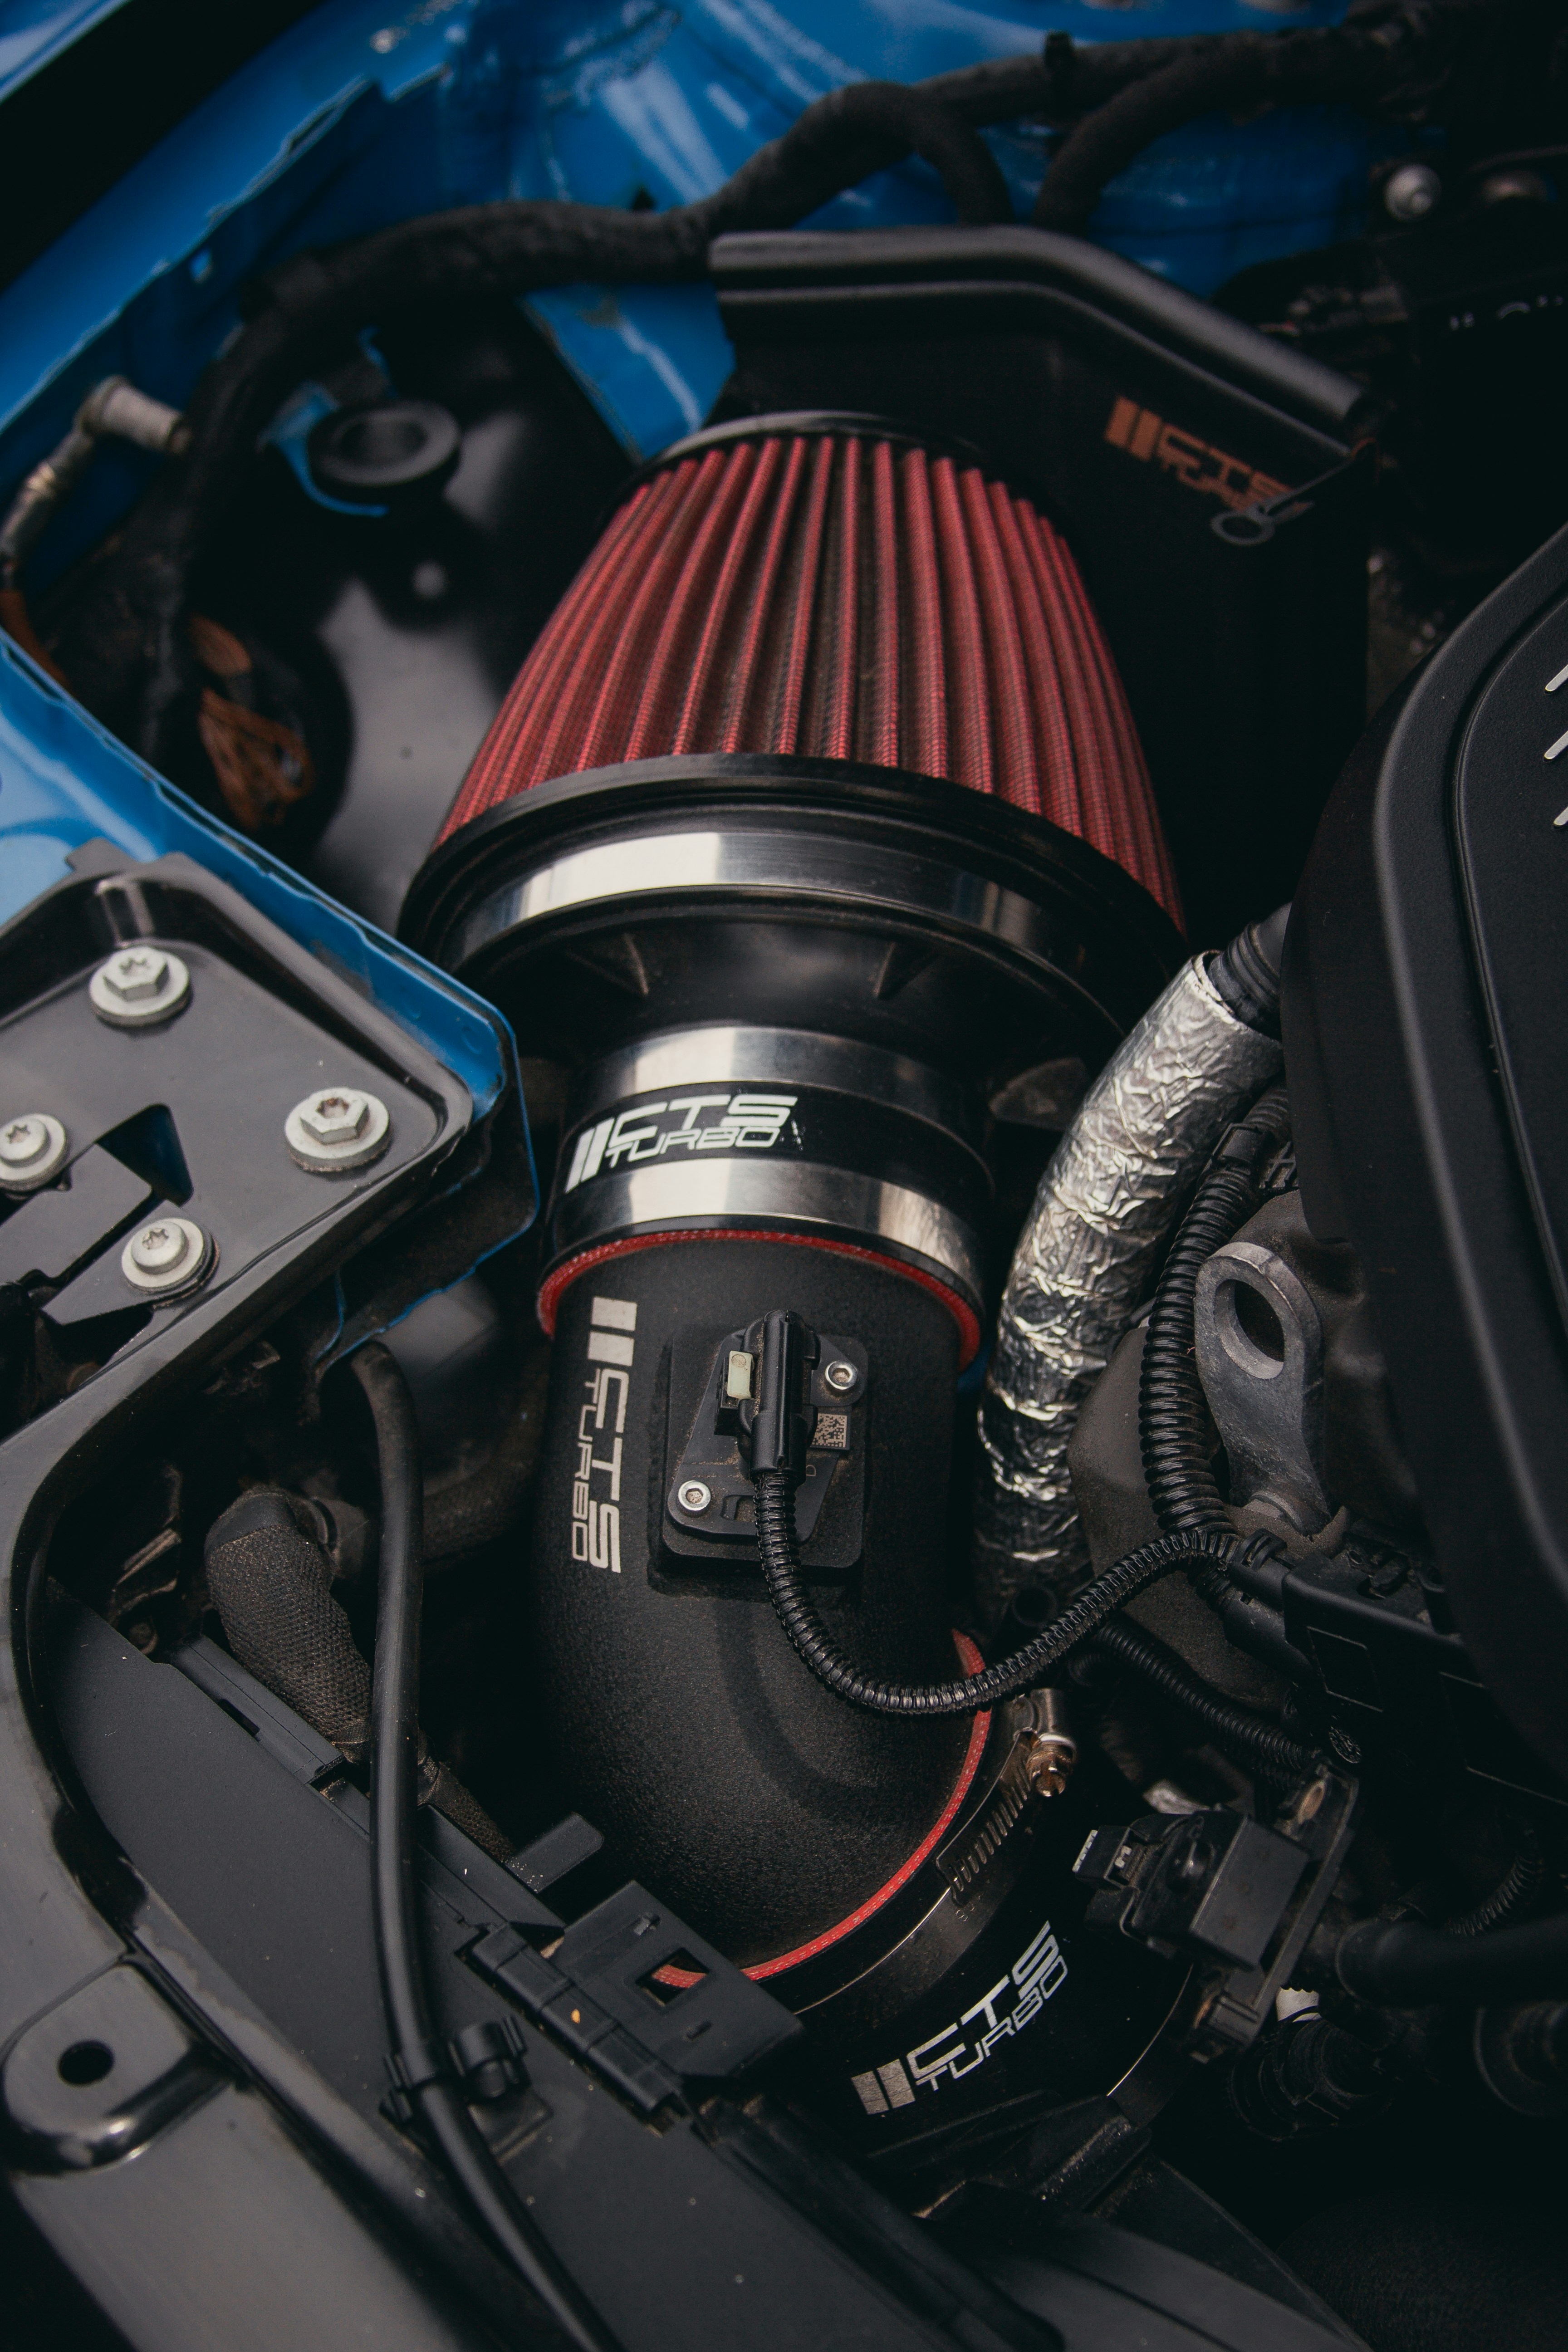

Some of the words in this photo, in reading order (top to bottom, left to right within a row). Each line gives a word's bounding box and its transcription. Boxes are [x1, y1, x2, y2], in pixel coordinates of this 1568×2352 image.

[605, 1127, 780, 1167] TURBO
[609, 1094, 798, 1142] CTS
[572, 1368, 601, 1562] TURBO
[588, 1368, 630, 1573] CTS
[906, 1920, 1059, 2079] CTS
[916, 1955, 1068, 2091] TURBO
